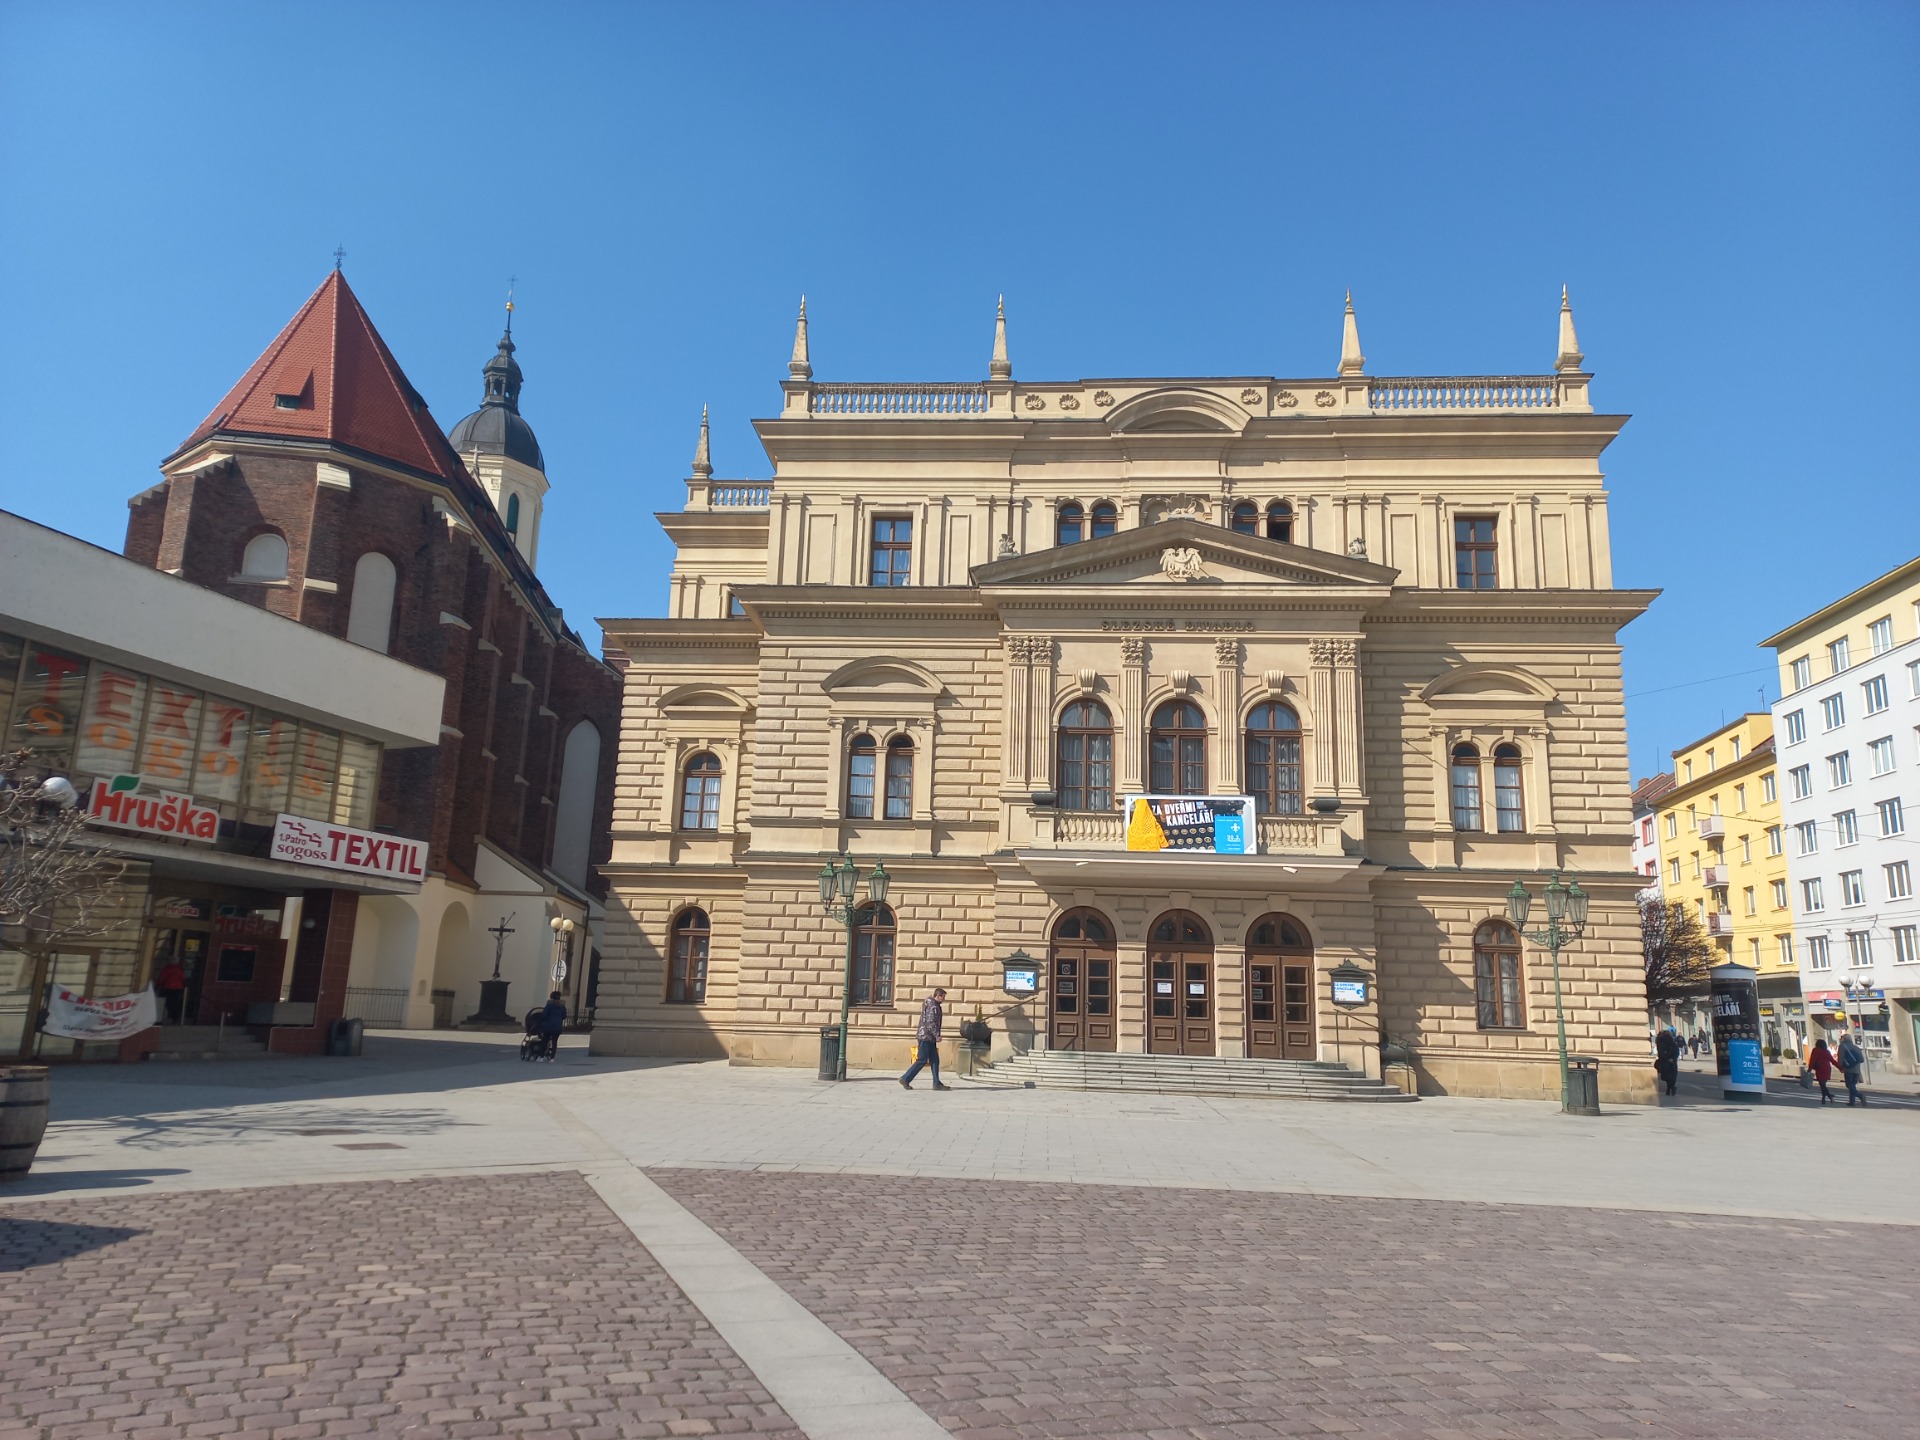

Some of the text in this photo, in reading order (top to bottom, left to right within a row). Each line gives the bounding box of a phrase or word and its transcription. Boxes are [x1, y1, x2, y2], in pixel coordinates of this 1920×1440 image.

[1101, 619, 1255, 632] SLEZSKÉ DIVADLO
[92, 782, 217, 838] Hruška
[1152, 805, 1162, 815] ZA
[1164, 800, 1196, 815] DVEŘMI
[1166, 809, 1214, 826] KANCELÁŘÍ
[279, 833, 307, 846] 1.Patro
[276, 843, 328, 860] sogoss
[327, 830, 422, 875] TEXTIL
